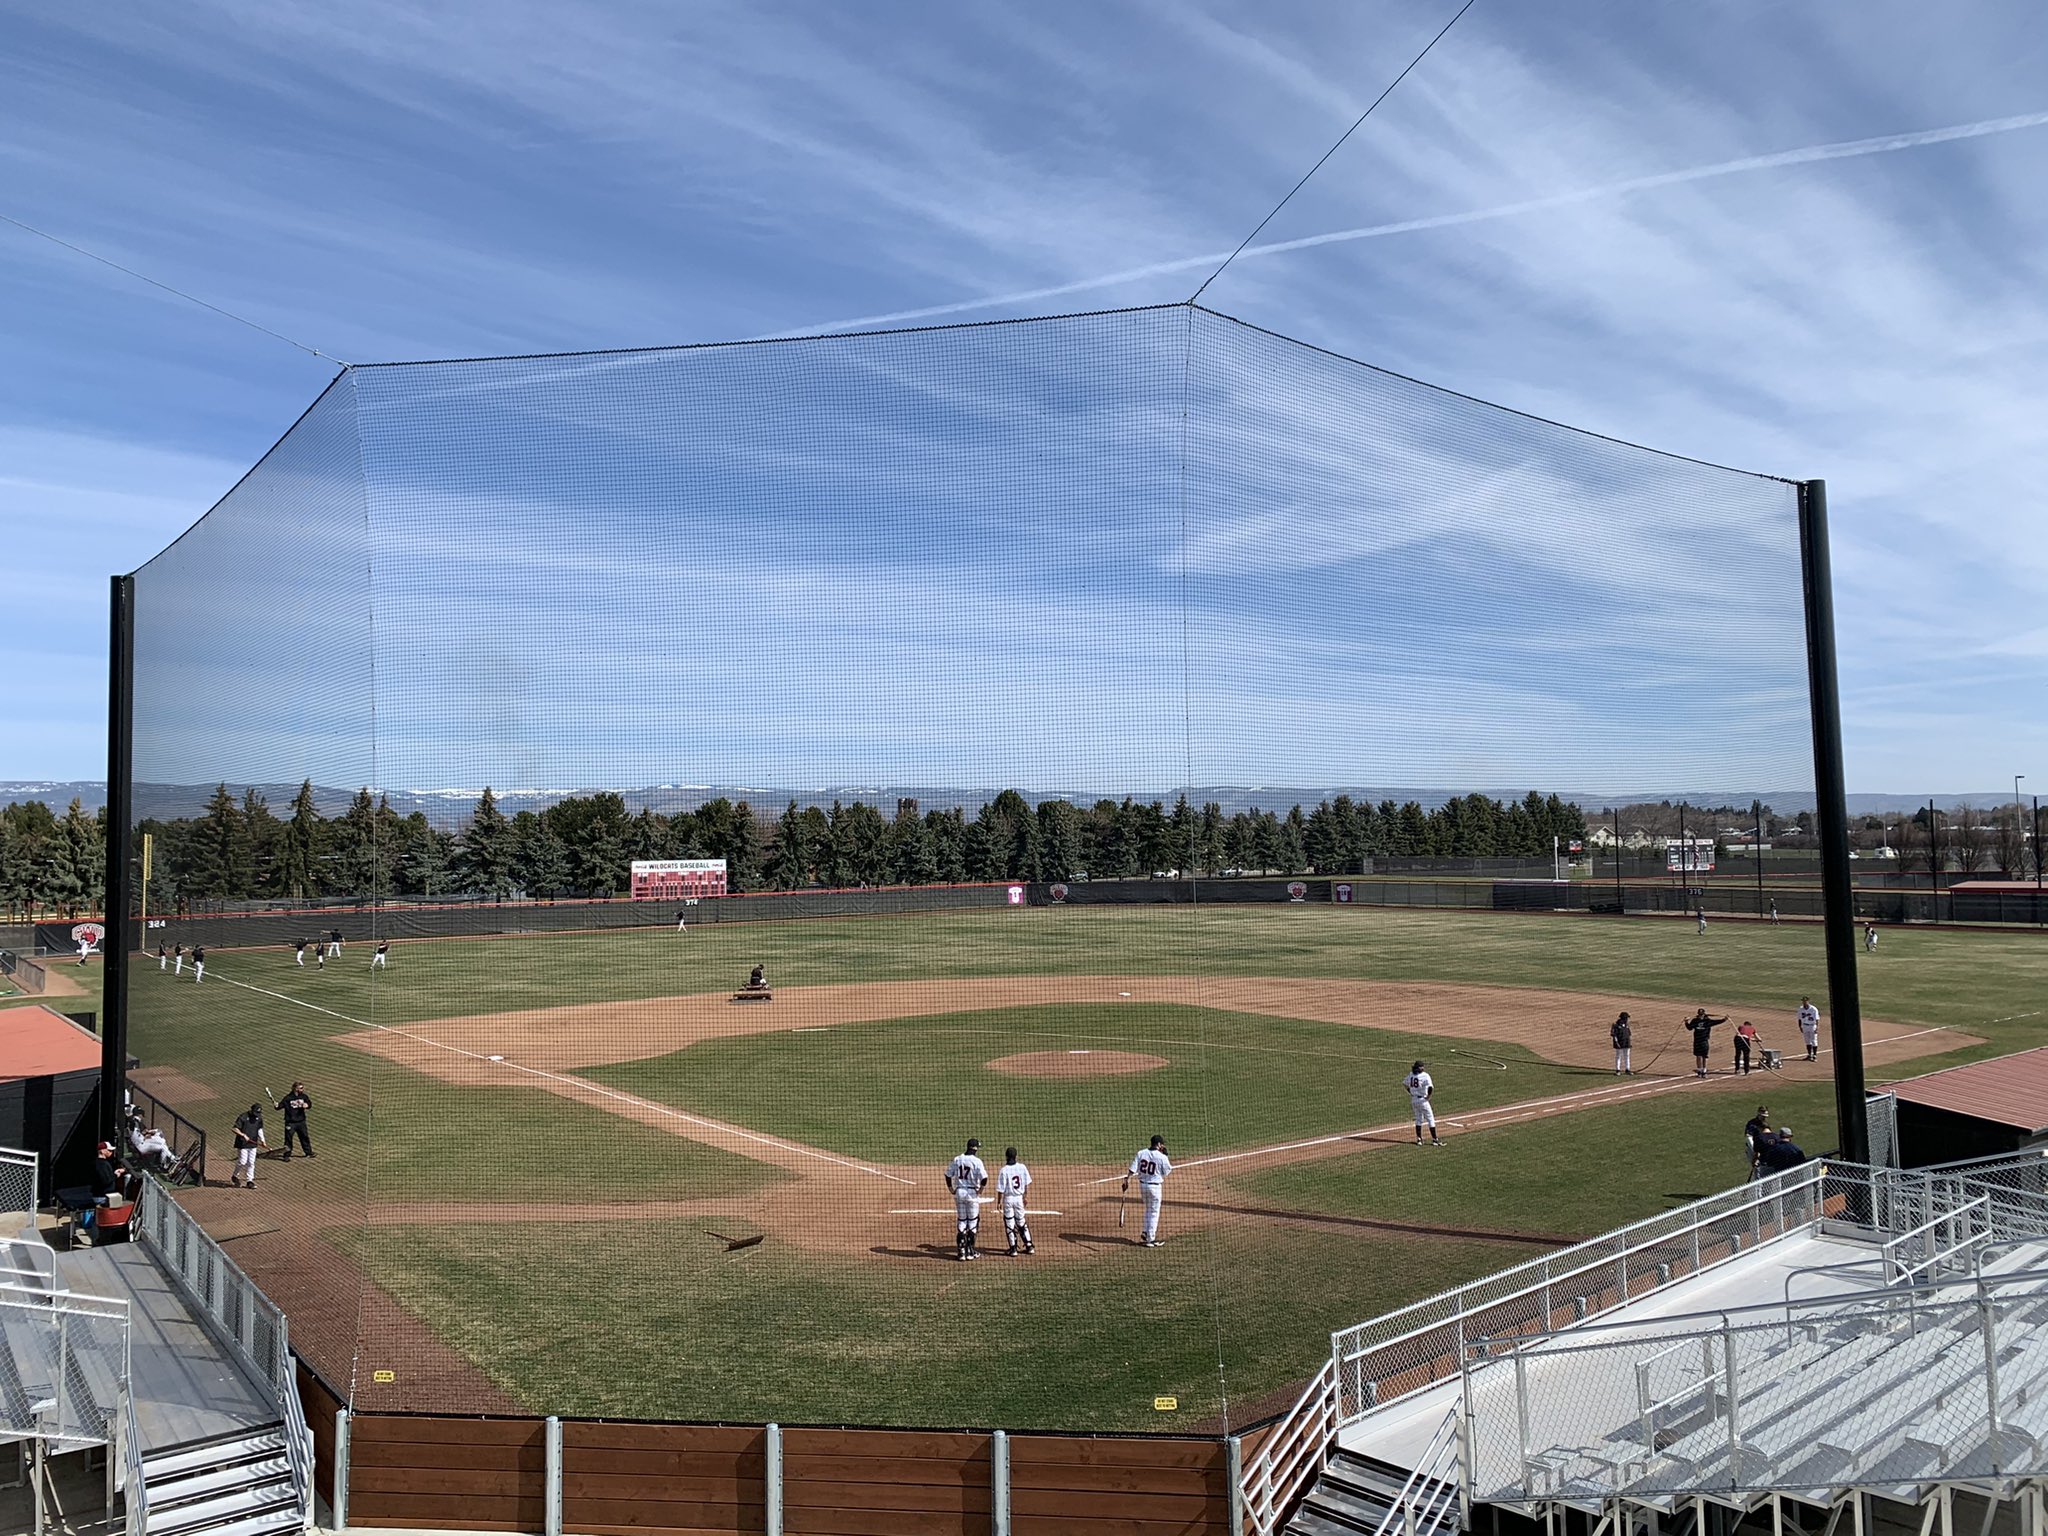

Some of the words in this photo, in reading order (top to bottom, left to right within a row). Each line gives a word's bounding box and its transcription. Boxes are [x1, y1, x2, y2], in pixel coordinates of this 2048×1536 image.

[1410, 1076, 1419, 1088] 18
[959, 1165, 971, 1180] 17
[1140, 1159, 1156, 1175] 20
[1012, 1175, 1021, 1189] 3
